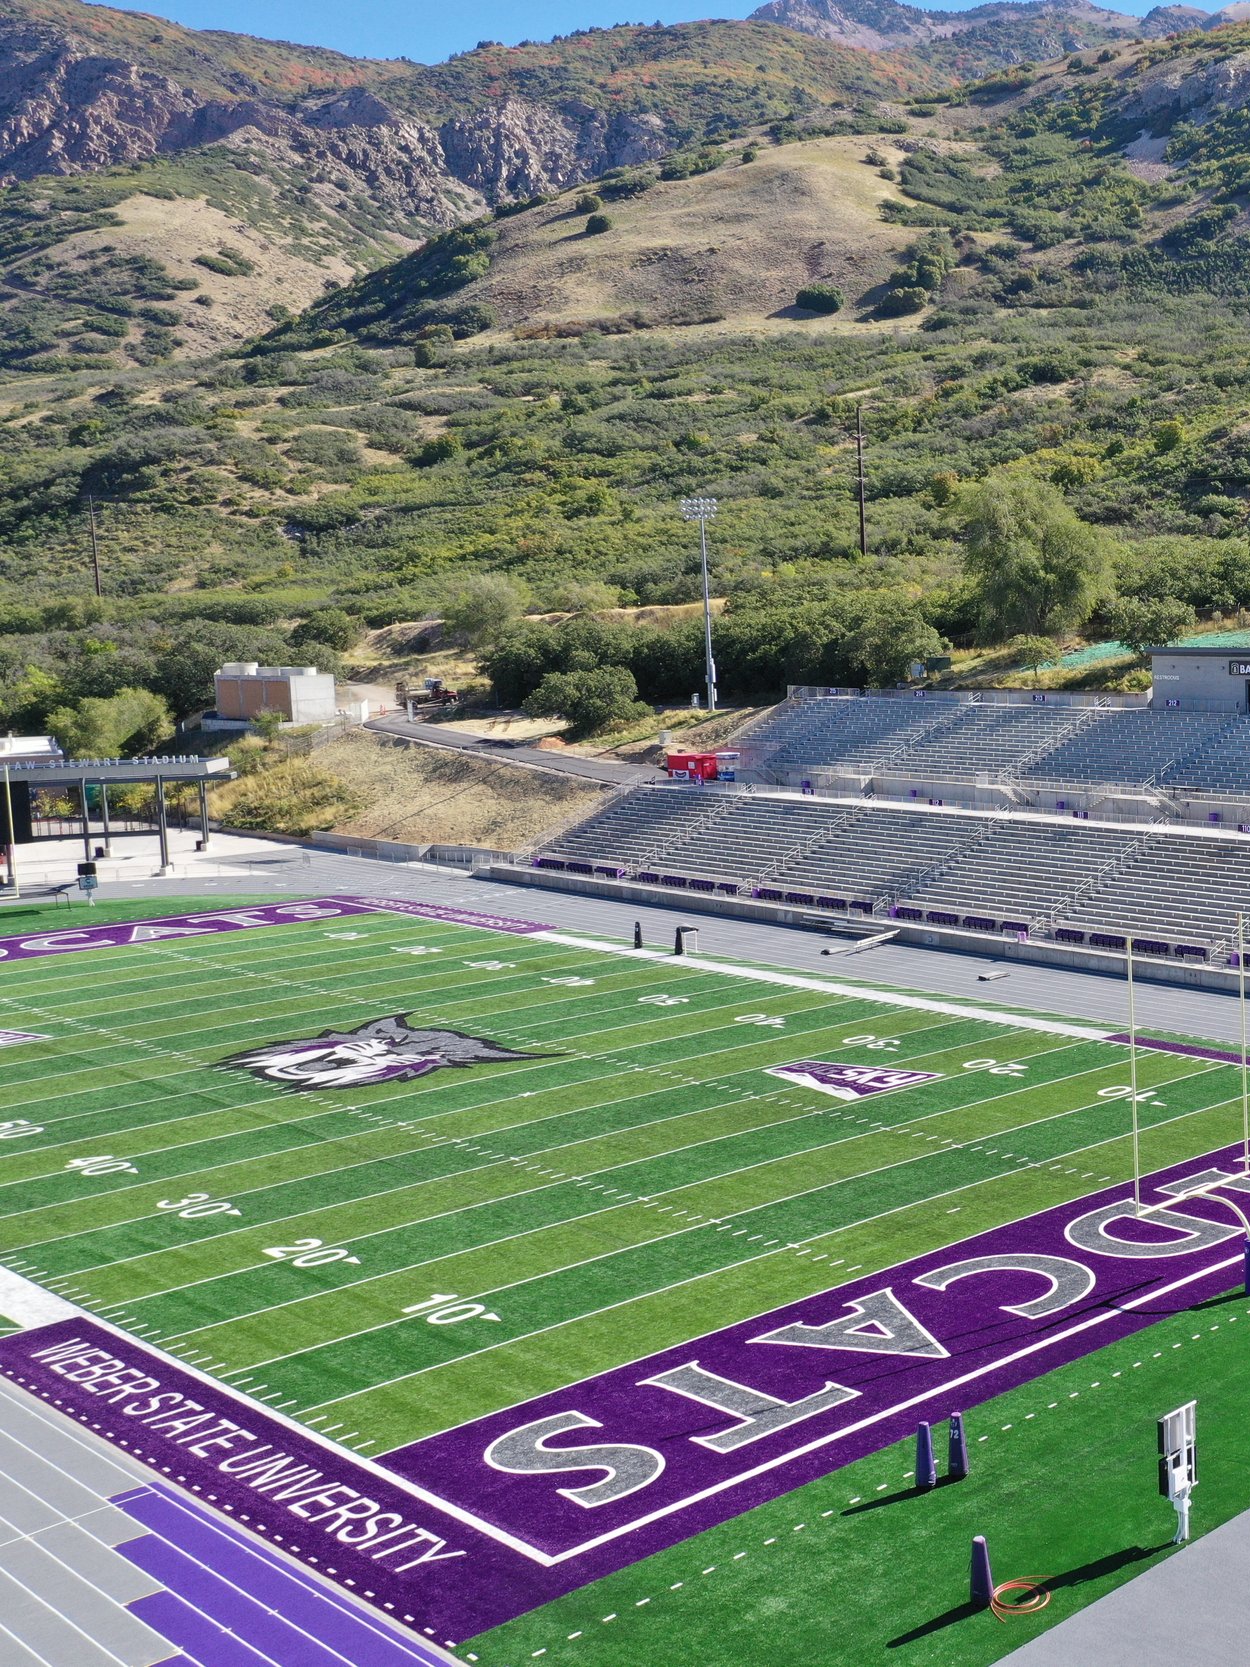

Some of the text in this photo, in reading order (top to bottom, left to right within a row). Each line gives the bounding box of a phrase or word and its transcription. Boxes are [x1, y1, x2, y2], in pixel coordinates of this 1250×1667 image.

[48, 757, 121, 769] STEWART
[132, 754, 200, 766] STADIUM
[1242, 825, 1250, 833] 110
[0, 904, 342, 957] CATS
[842, 1035, 901, 1050] 30
[962, 1058, 1030, 1075] 20
[64, 1155, 132, 1176] 40
[156, 1193, 232, 1219] 30
[262, 1238, 349, 1268] 20
[401, 1293, 486, 1325] 10
[30, 1337, 467, 1574] WEBER STATE UNIVERSITY
